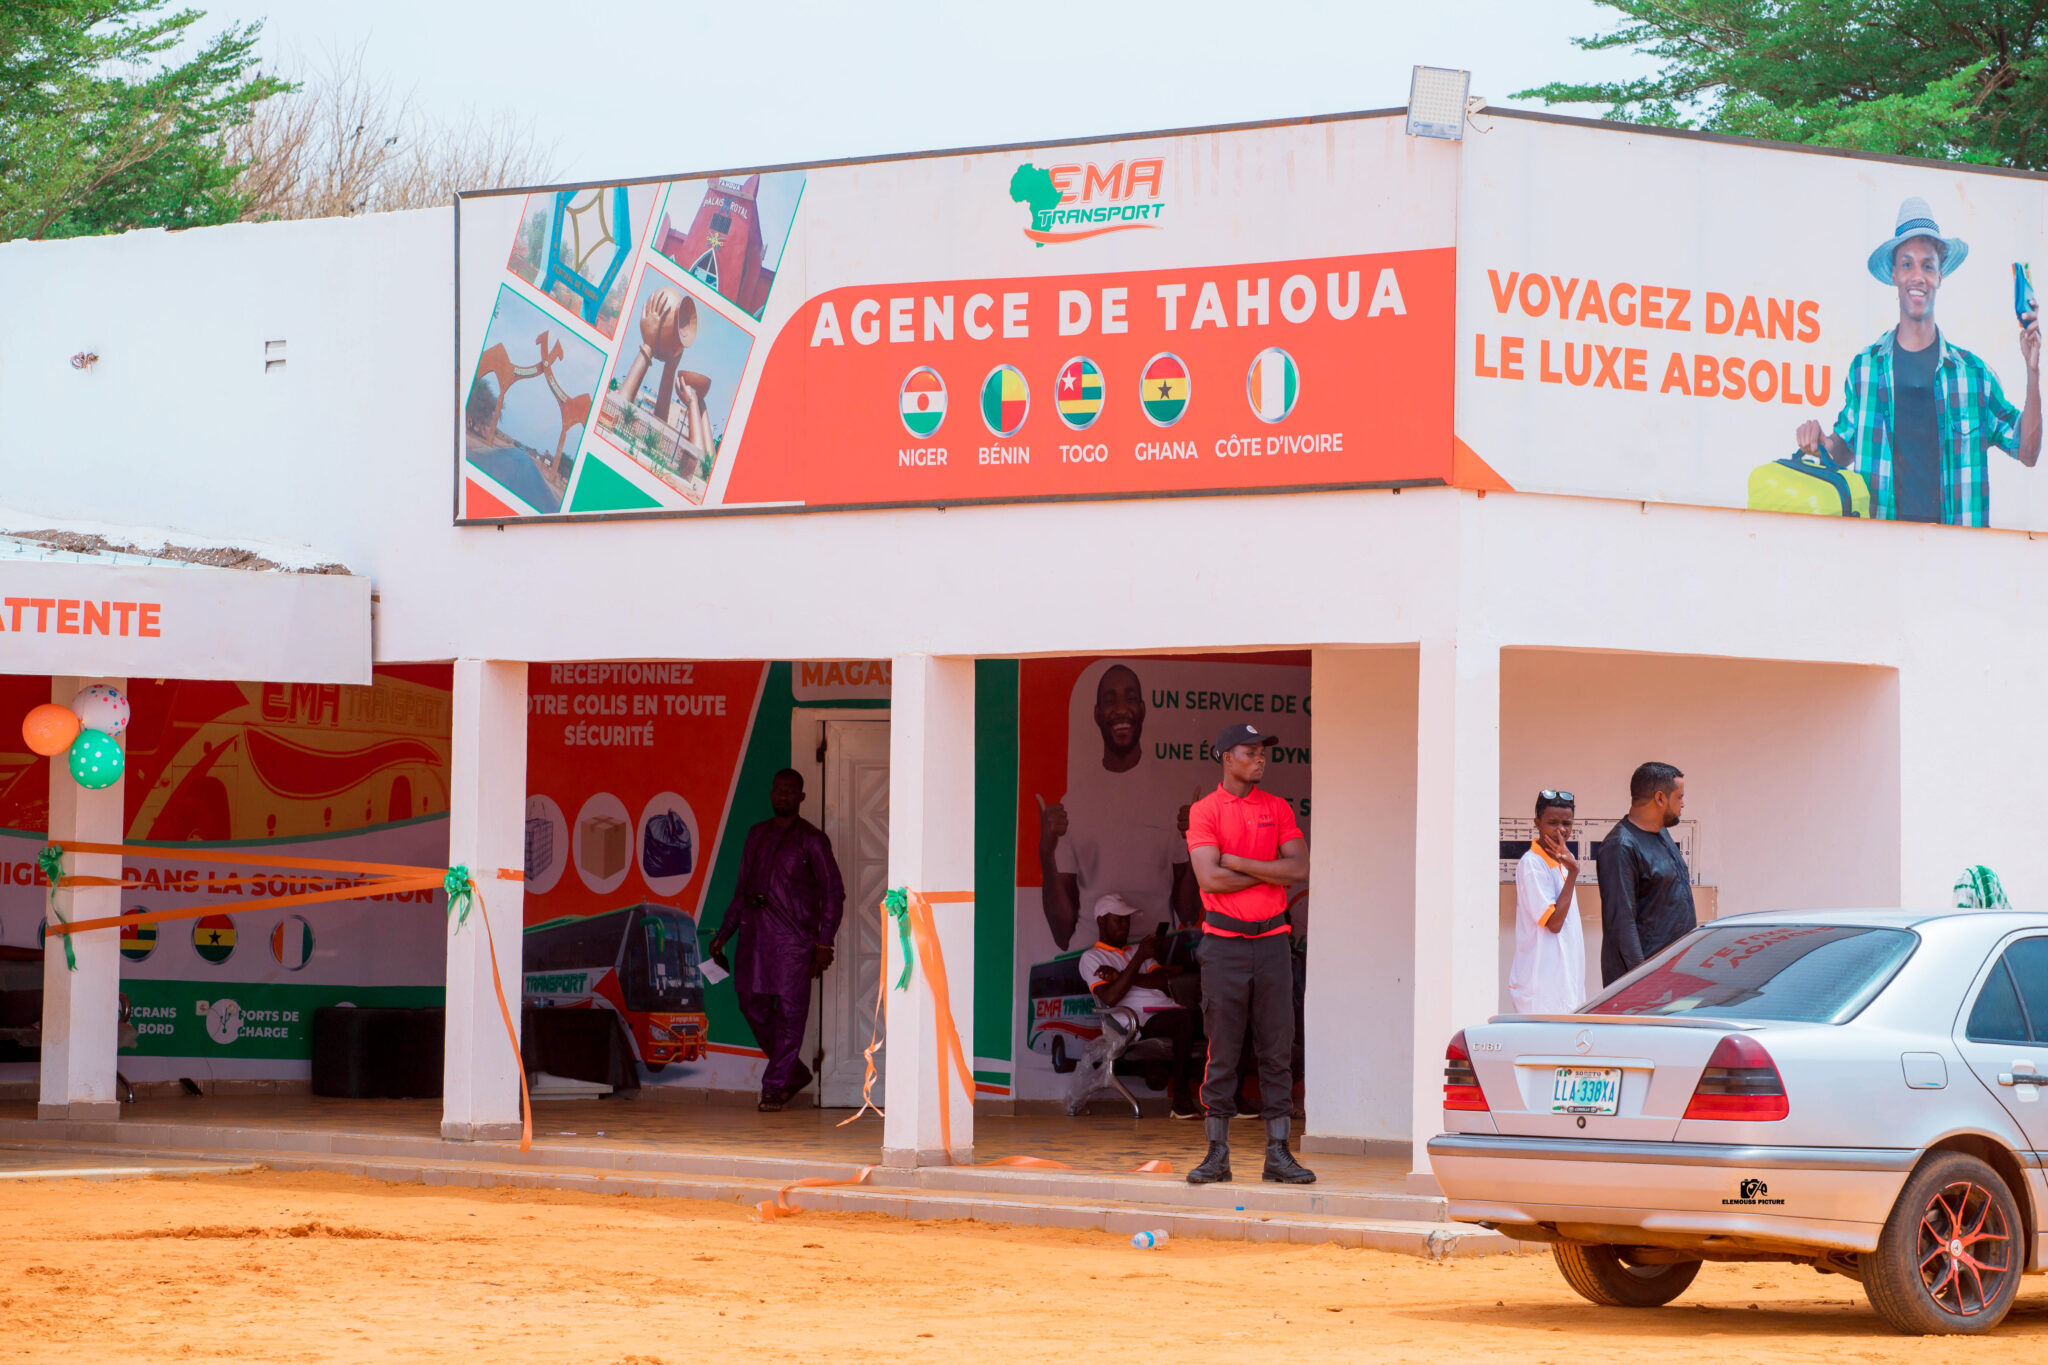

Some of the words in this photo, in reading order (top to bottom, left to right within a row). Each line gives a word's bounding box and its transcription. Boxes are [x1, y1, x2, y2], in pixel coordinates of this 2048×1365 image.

[1048, 157, 1166, 203] EMA
[703, 197, 725, 208] PALAIS
[729, 201, 748, 219] ROYAL
[1038, 203, 1166, 228] TRANSPORT
[810, 291, 1030, 347] AGENCE
[1058, 287, 1129, 337] DE
[1156, 267, 1407, 331] TAHOUA
[1487, 269, 1691, 332] VOYAGEZ
[1705, 292, 1821, 344] DANS
[1475, 334, 1525, 380] LE
[1539, 339, 1648, 392] LUXE
[1660, 352, 1832, 408] ABSOLU
[898, 447, 948, 467] NIGER
[978, 442, 1030, 466] BÉNIN
[1059, 443, 1108, 463] TOGO
[1135, 440, 1199, 461] GHANA
[1215, 434, 1262, 458] CÔTE
[1267, 432, 1343, 457] D'IVOIRE
[550, 663, 694, 685] RECEPTIONNEZ
[527, 694, 568, 716] TRE
[574, 694, 627, 716] COLIS
[633, 694, 659, 716] EN
[664, 694, 726, 716] TOUTE
[1152, 690, 1180, 709] UN
[1185, 692, 1265, 713] SERVICE
[1271, 695, 1297, 714] DE
[564, 720, 654, 746] SÉCURITÉ
[1155, 743, 1193, 761] UNE
[122, 867, 197, 894] DANS
[207, 870, 243, 897] LA
[526, 973, 587, 993] TRANSPORT
[283, 1010, 300, 1023] DE
[1036, 998, 1062, 1018] EMA
[138, 1022, 175, 1036] BORD
